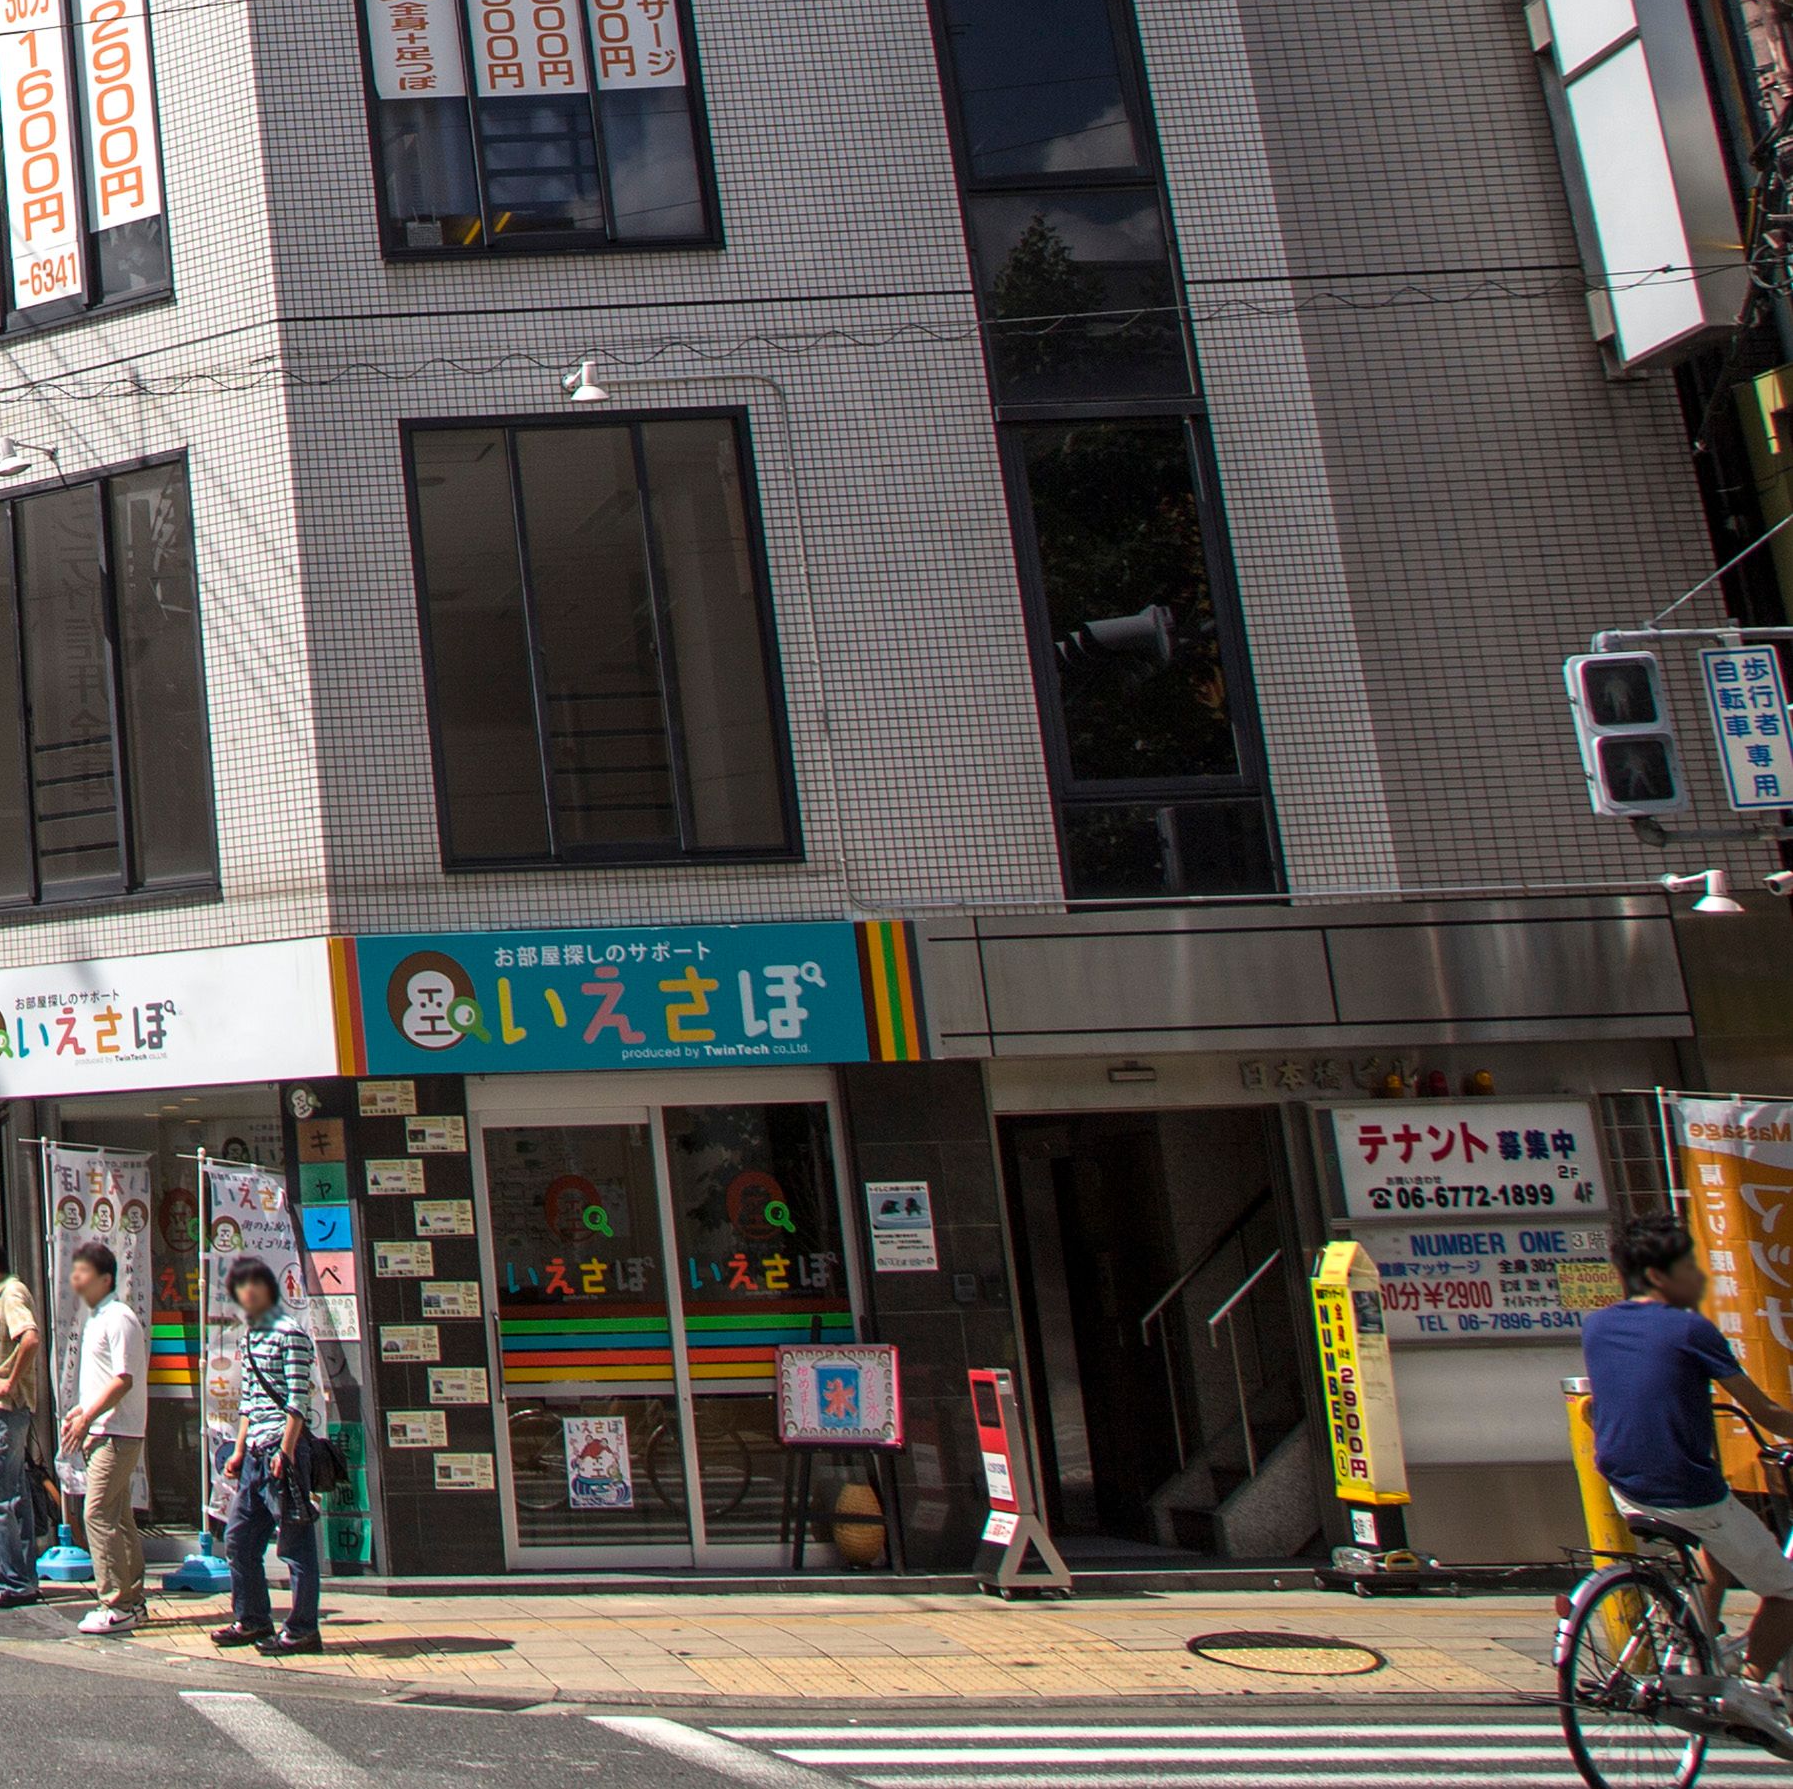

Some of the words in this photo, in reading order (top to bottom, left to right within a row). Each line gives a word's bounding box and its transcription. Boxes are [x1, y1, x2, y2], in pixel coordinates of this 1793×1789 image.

[89, 0, 144, 215] 2900円
[16, 30, 66, 243] 1600円
[1714, 661, 1752, 738] 自転車
[1742, 657, 1780, 736] 歩行者
[1745, 744, 1780, 798] 専用
[494, 941, 711, 968] お部屋探しのサポート
[15, 989, 120, 1010] お部屋探しのサポート
[497, 960, 826, 1044] いえさぽ
[16, 1000, 176, 1058] いえさぽ
[622, 1046, 680, 1060] produced
[685, 1046, 700, 1059] by
[704, 1043, 769, 1057] TwinTech
[1358, 1122, 1489, 1163] テナント
[1496, 1129, 1575, 1160] 募集中
[1397, 1183, 1555, 1208] 06-6772-1899
[1574, 1182, 1594, 1203] 4F
[1557, 1165, 1579, 1179] 2F
[1410, 1232, 1506, 1257] NUMBER
[1519, 1230, 1567, 1253] ONE
[1417, 1316, 1448, 1331] TEL
[1458, 1312, 1582, 1331] 06-7896-6341
[1340, 1367, 1369, 1479] 2900円
